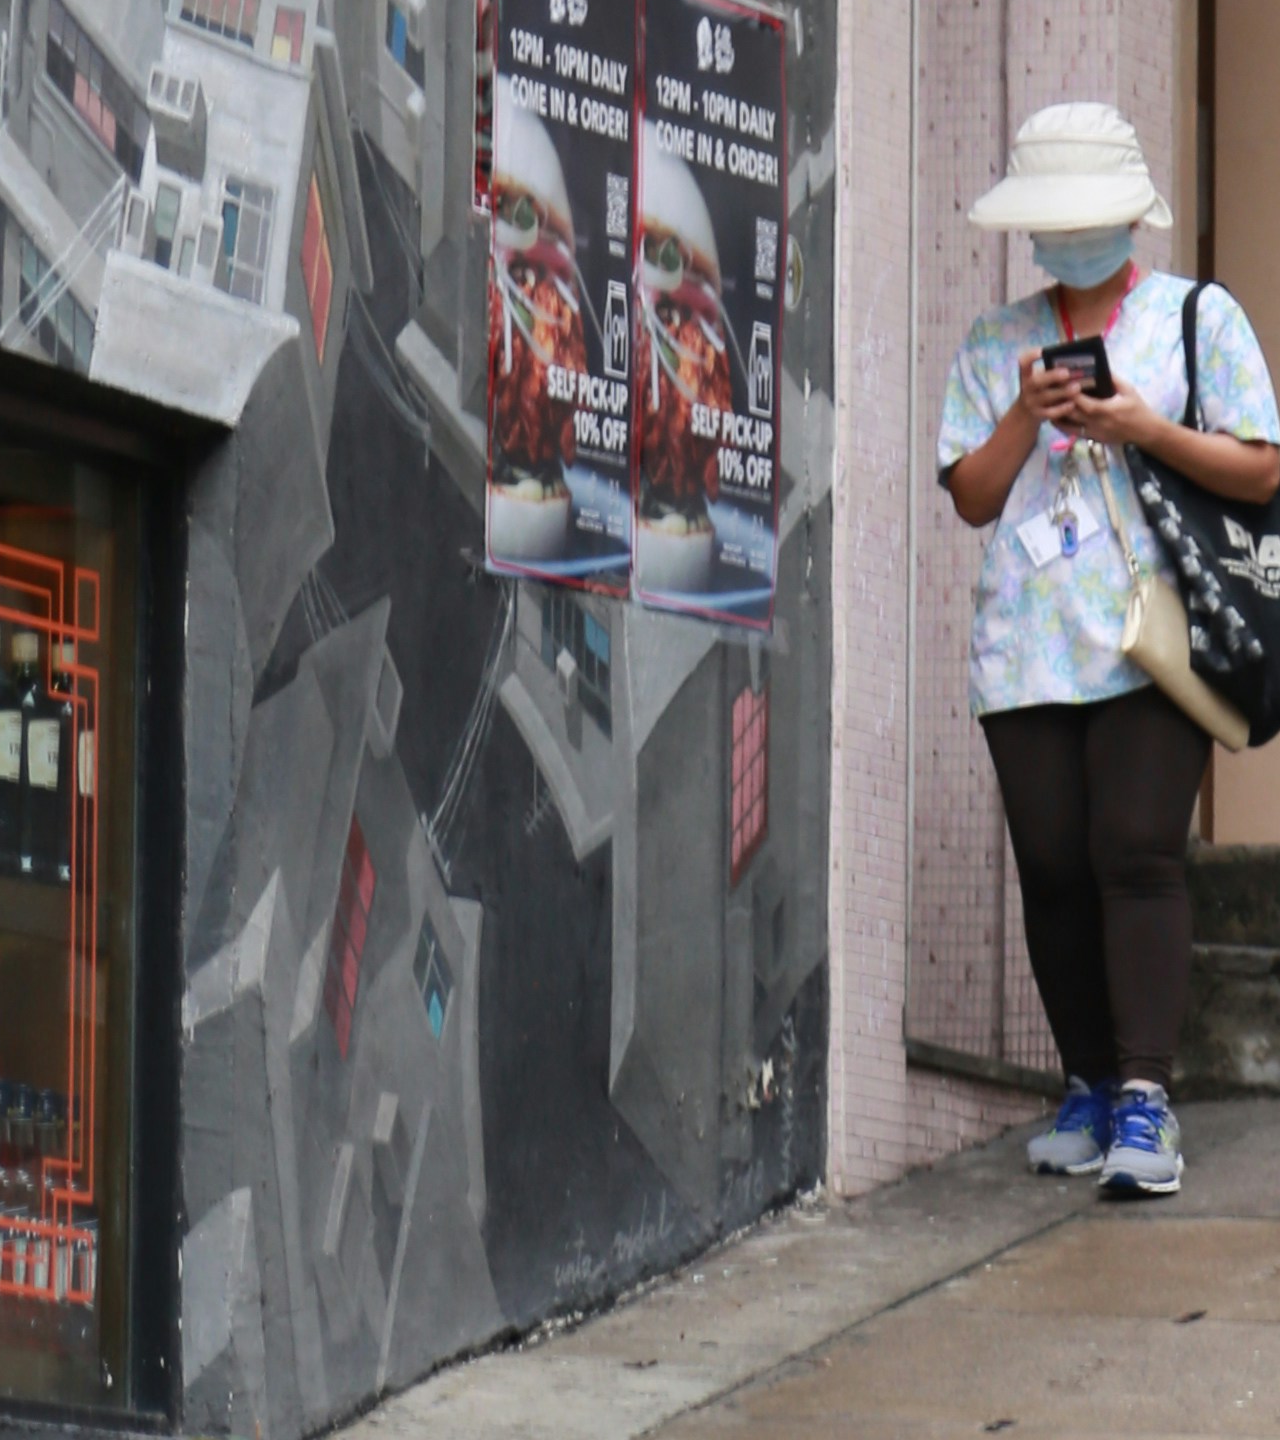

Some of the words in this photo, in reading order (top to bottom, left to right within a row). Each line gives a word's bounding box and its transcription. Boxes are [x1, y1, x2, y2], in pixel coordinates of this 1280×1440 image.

[510, 27, 544, 70] 12PM
[554, 42, 589, 84] 10PM
[591, 53, 628, 96] DAILY
[510, 73, 547, 117] COME
[550, 86, 565, 122] IN
[567, 92, 578, 126] &
[580, 96, 629, 143] ORDER!
[656, 73, 691, 116] 12PM
[702, 89, 737, 131] 10PM
[739, 100, 776, 143] DAILY
[656, 119, 695, 162] COME
[697, 131, 712, 167] IN
[714, 137, 725, 172] &
[728, 142, 779, 188] ORDER!
[547, 363, 576, 402] SELF
[578, 372, 629, 416] PICK-UP
[573, 409, 600, 448] 10%
[602, 416, 628, 453] OFF
[691, 402, 720, 440] SELF
[722, 411, 773, 457] PICK-UP
[718, 446, 744, 483] 10%
[746, 453, 773, 491] OFF
